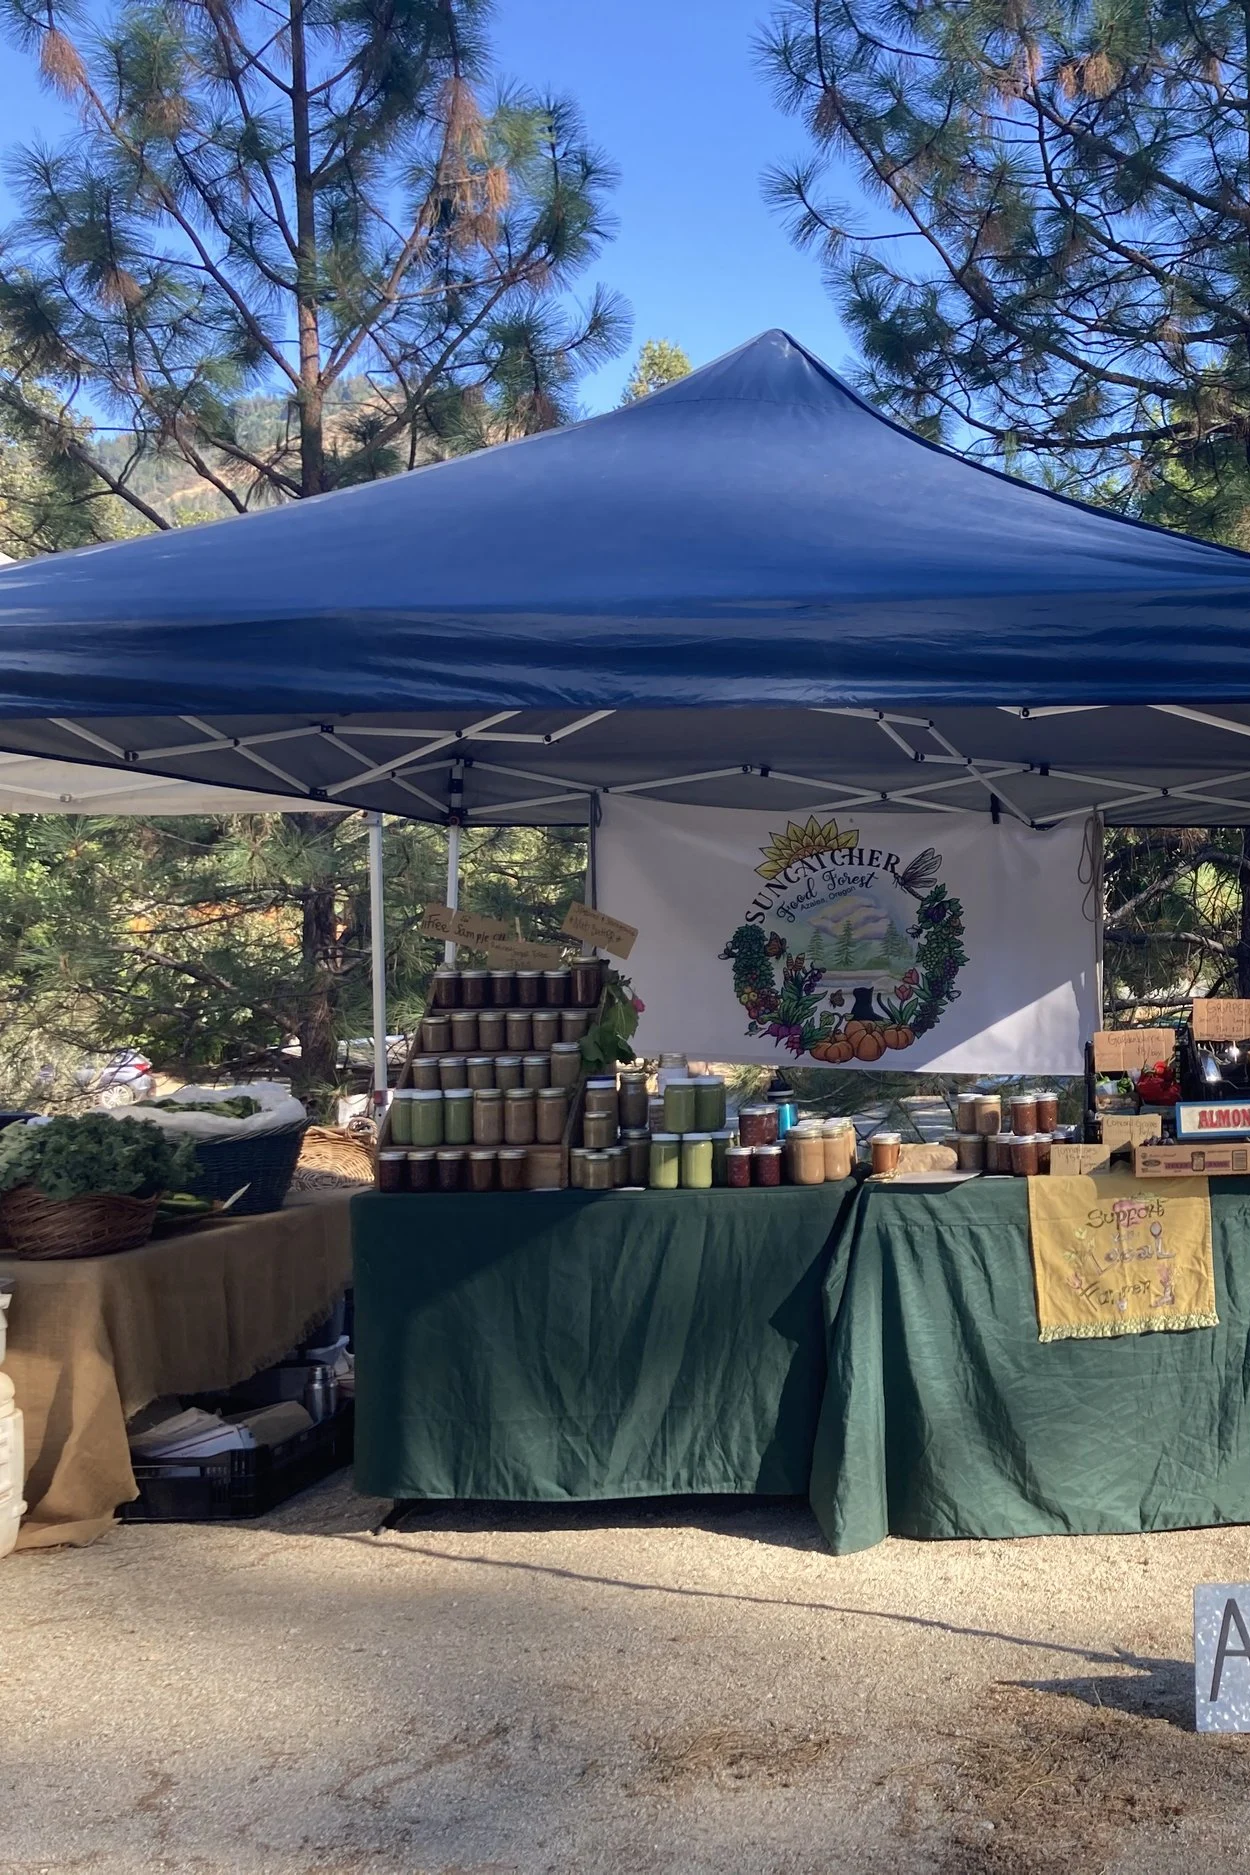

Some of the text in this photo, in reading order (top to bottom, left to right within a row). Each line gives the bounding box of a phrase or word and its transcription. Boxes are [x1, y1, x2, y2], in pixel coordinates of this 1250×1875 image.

[745, 848, 901, 924] SUNCATCHER
[776, 868, 879, 923] Food Forest
[828, 886, 856, 900] Oregon
[1086, 1199, 1167, 1230] Support
